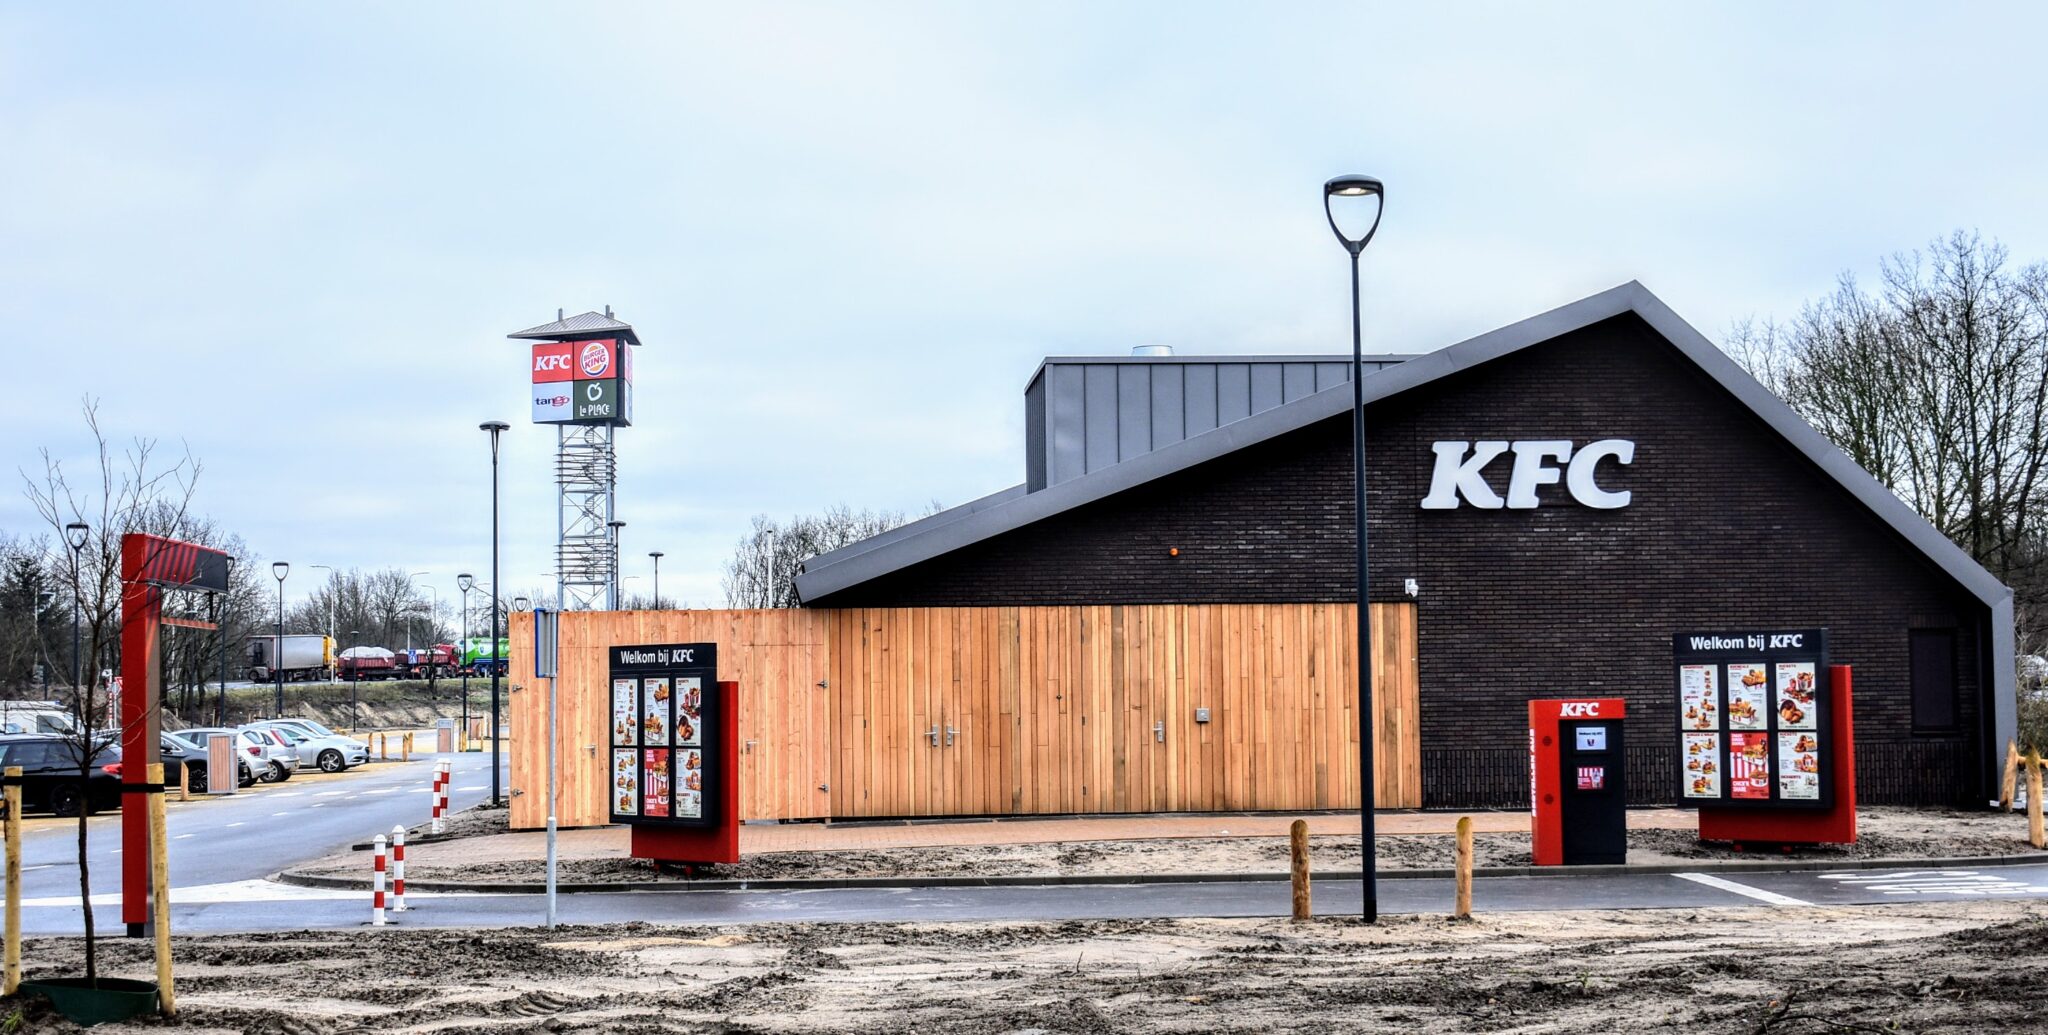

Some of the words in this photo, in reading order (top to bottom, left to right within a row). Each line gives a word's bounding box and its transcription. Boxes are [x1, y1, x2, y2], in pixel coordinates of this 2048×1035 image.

[534, 354, 571, 371] KFC
[583, 348, 605, 361] BURGER
[584, 354, 606, 369] KING
[588, 403, 610, 416] PLACE
[1420, 439, 1635, 509] KFC
[1690, 636, 1744, 650] Welkom
[1747, 635, 1765, 651] bij
[1769, 634, 1803, 648] KFC
[620, 650, 656, 664] Welkom
[657, 649, 669, 666] bij
[671, 649, 694, 663] KFC
[1560, 702, 1600, 717] KFC
